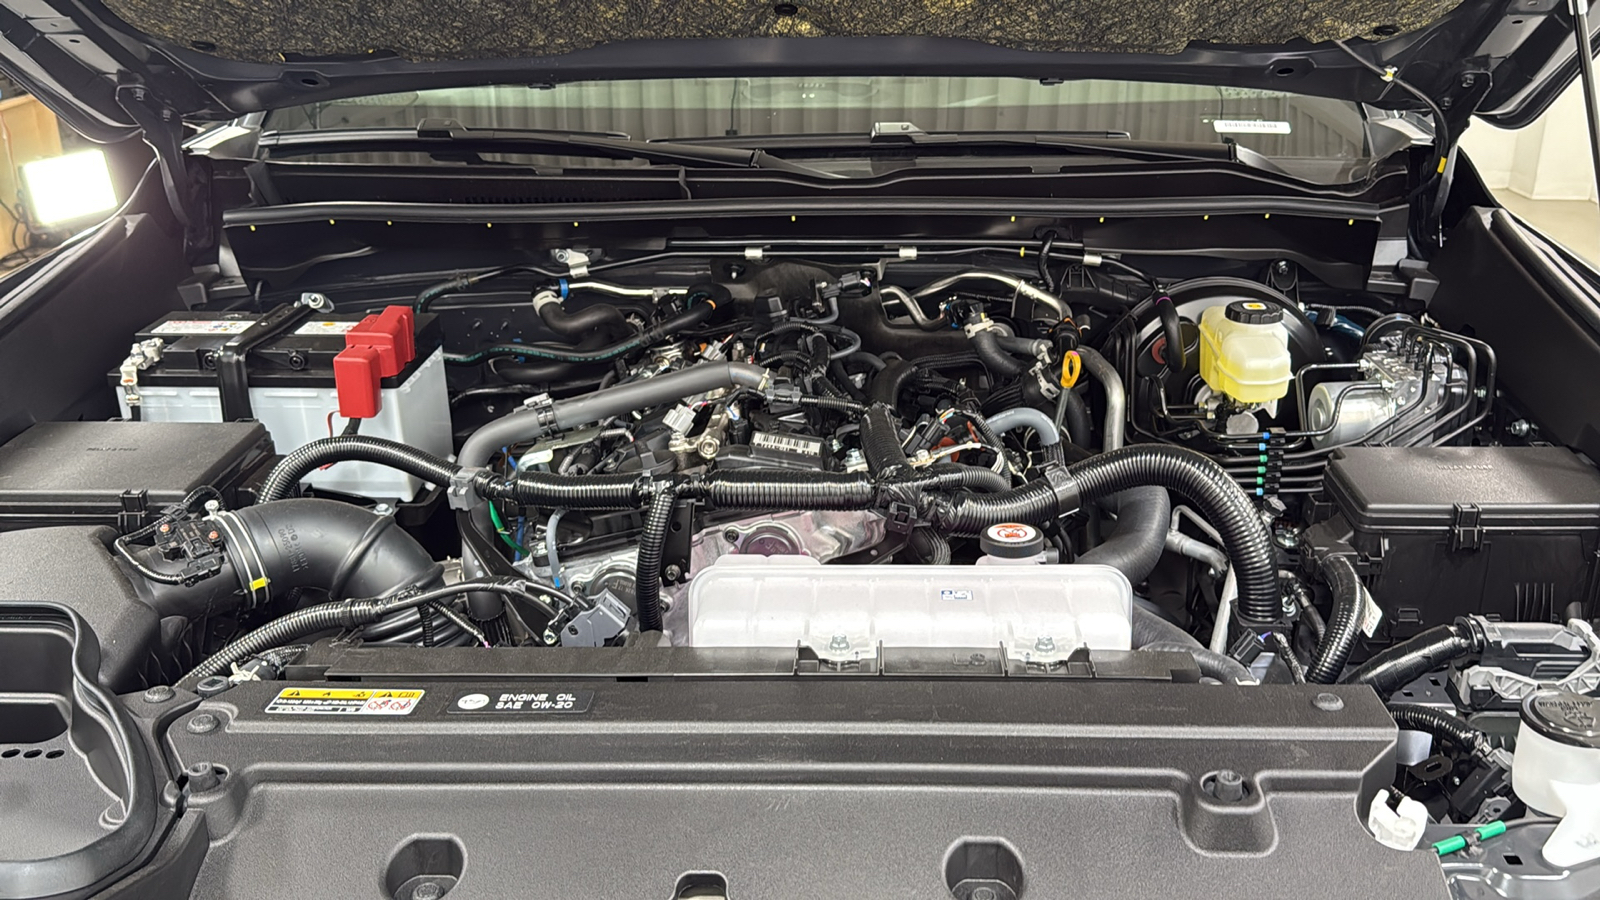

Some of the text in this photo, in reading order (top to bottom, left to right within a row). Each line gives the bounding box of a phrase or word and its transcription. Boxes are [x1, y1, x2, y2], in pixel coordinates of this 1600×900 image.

[499, 693, 576, 701] ENGINE OIL
[495, 701, 524, 709] SAE
[531, 701, 574, 709] 0W-20
